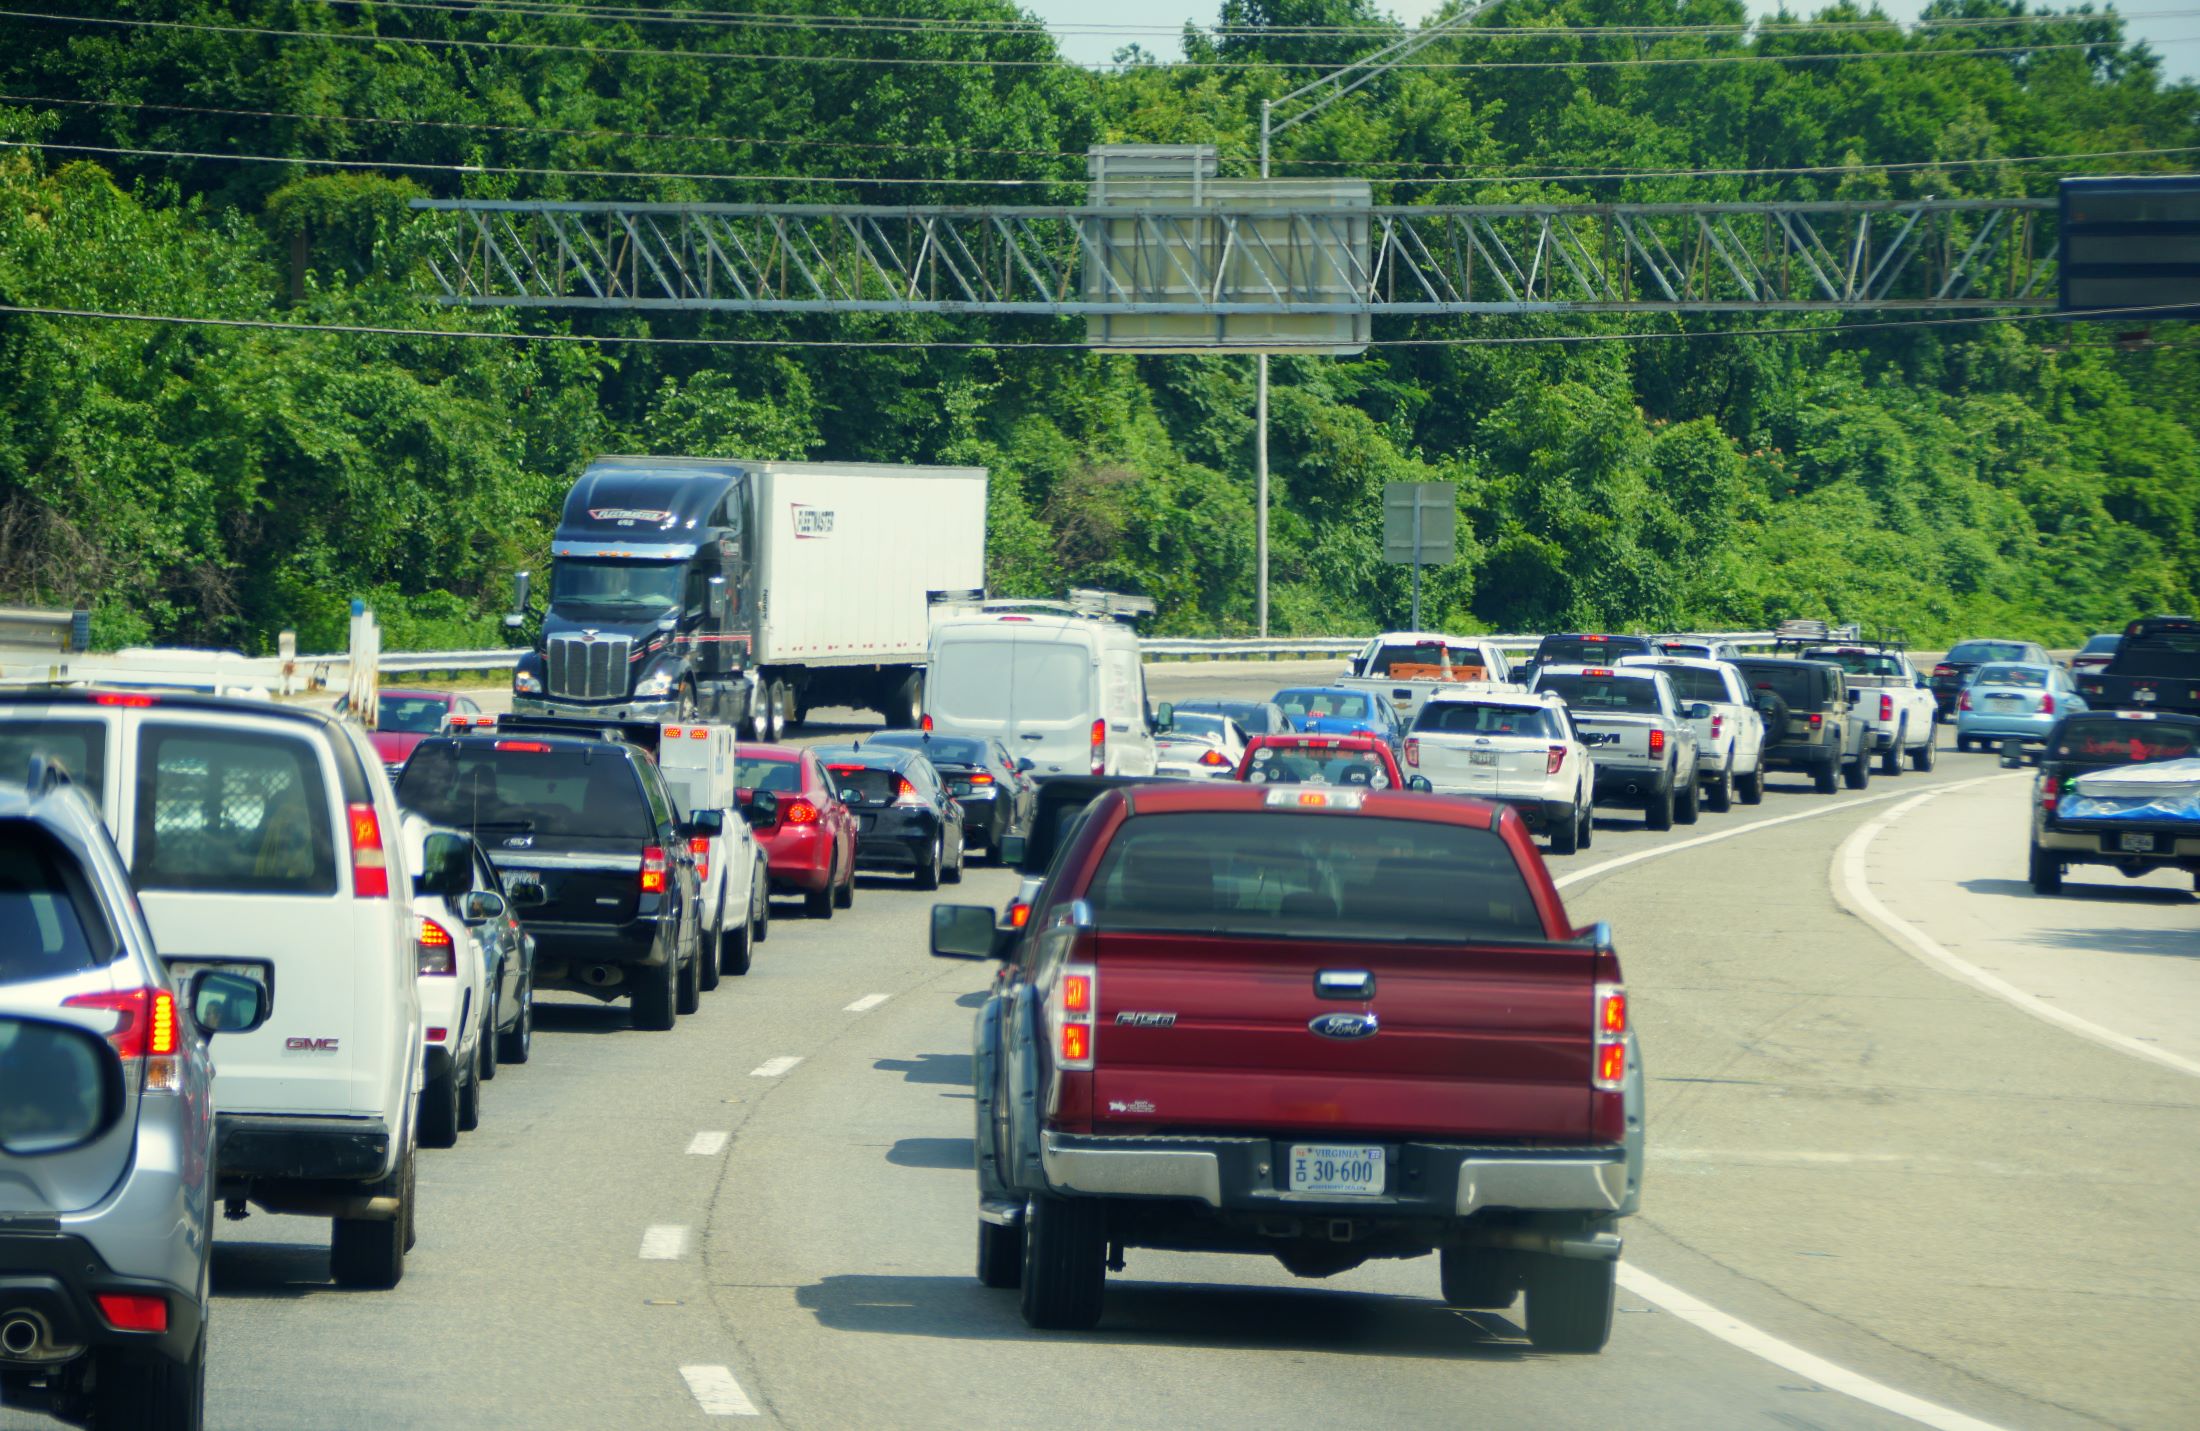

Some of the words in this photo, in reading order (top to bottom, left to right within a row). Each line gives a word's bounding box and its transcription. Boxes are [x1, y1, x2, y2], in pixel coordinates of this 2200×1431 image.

[1325, 1016, 1363, 1035] Ford
[286, 1037, 339, 1051] GMC
[1315, 1149, 1359, 1159] VIRGINIA
